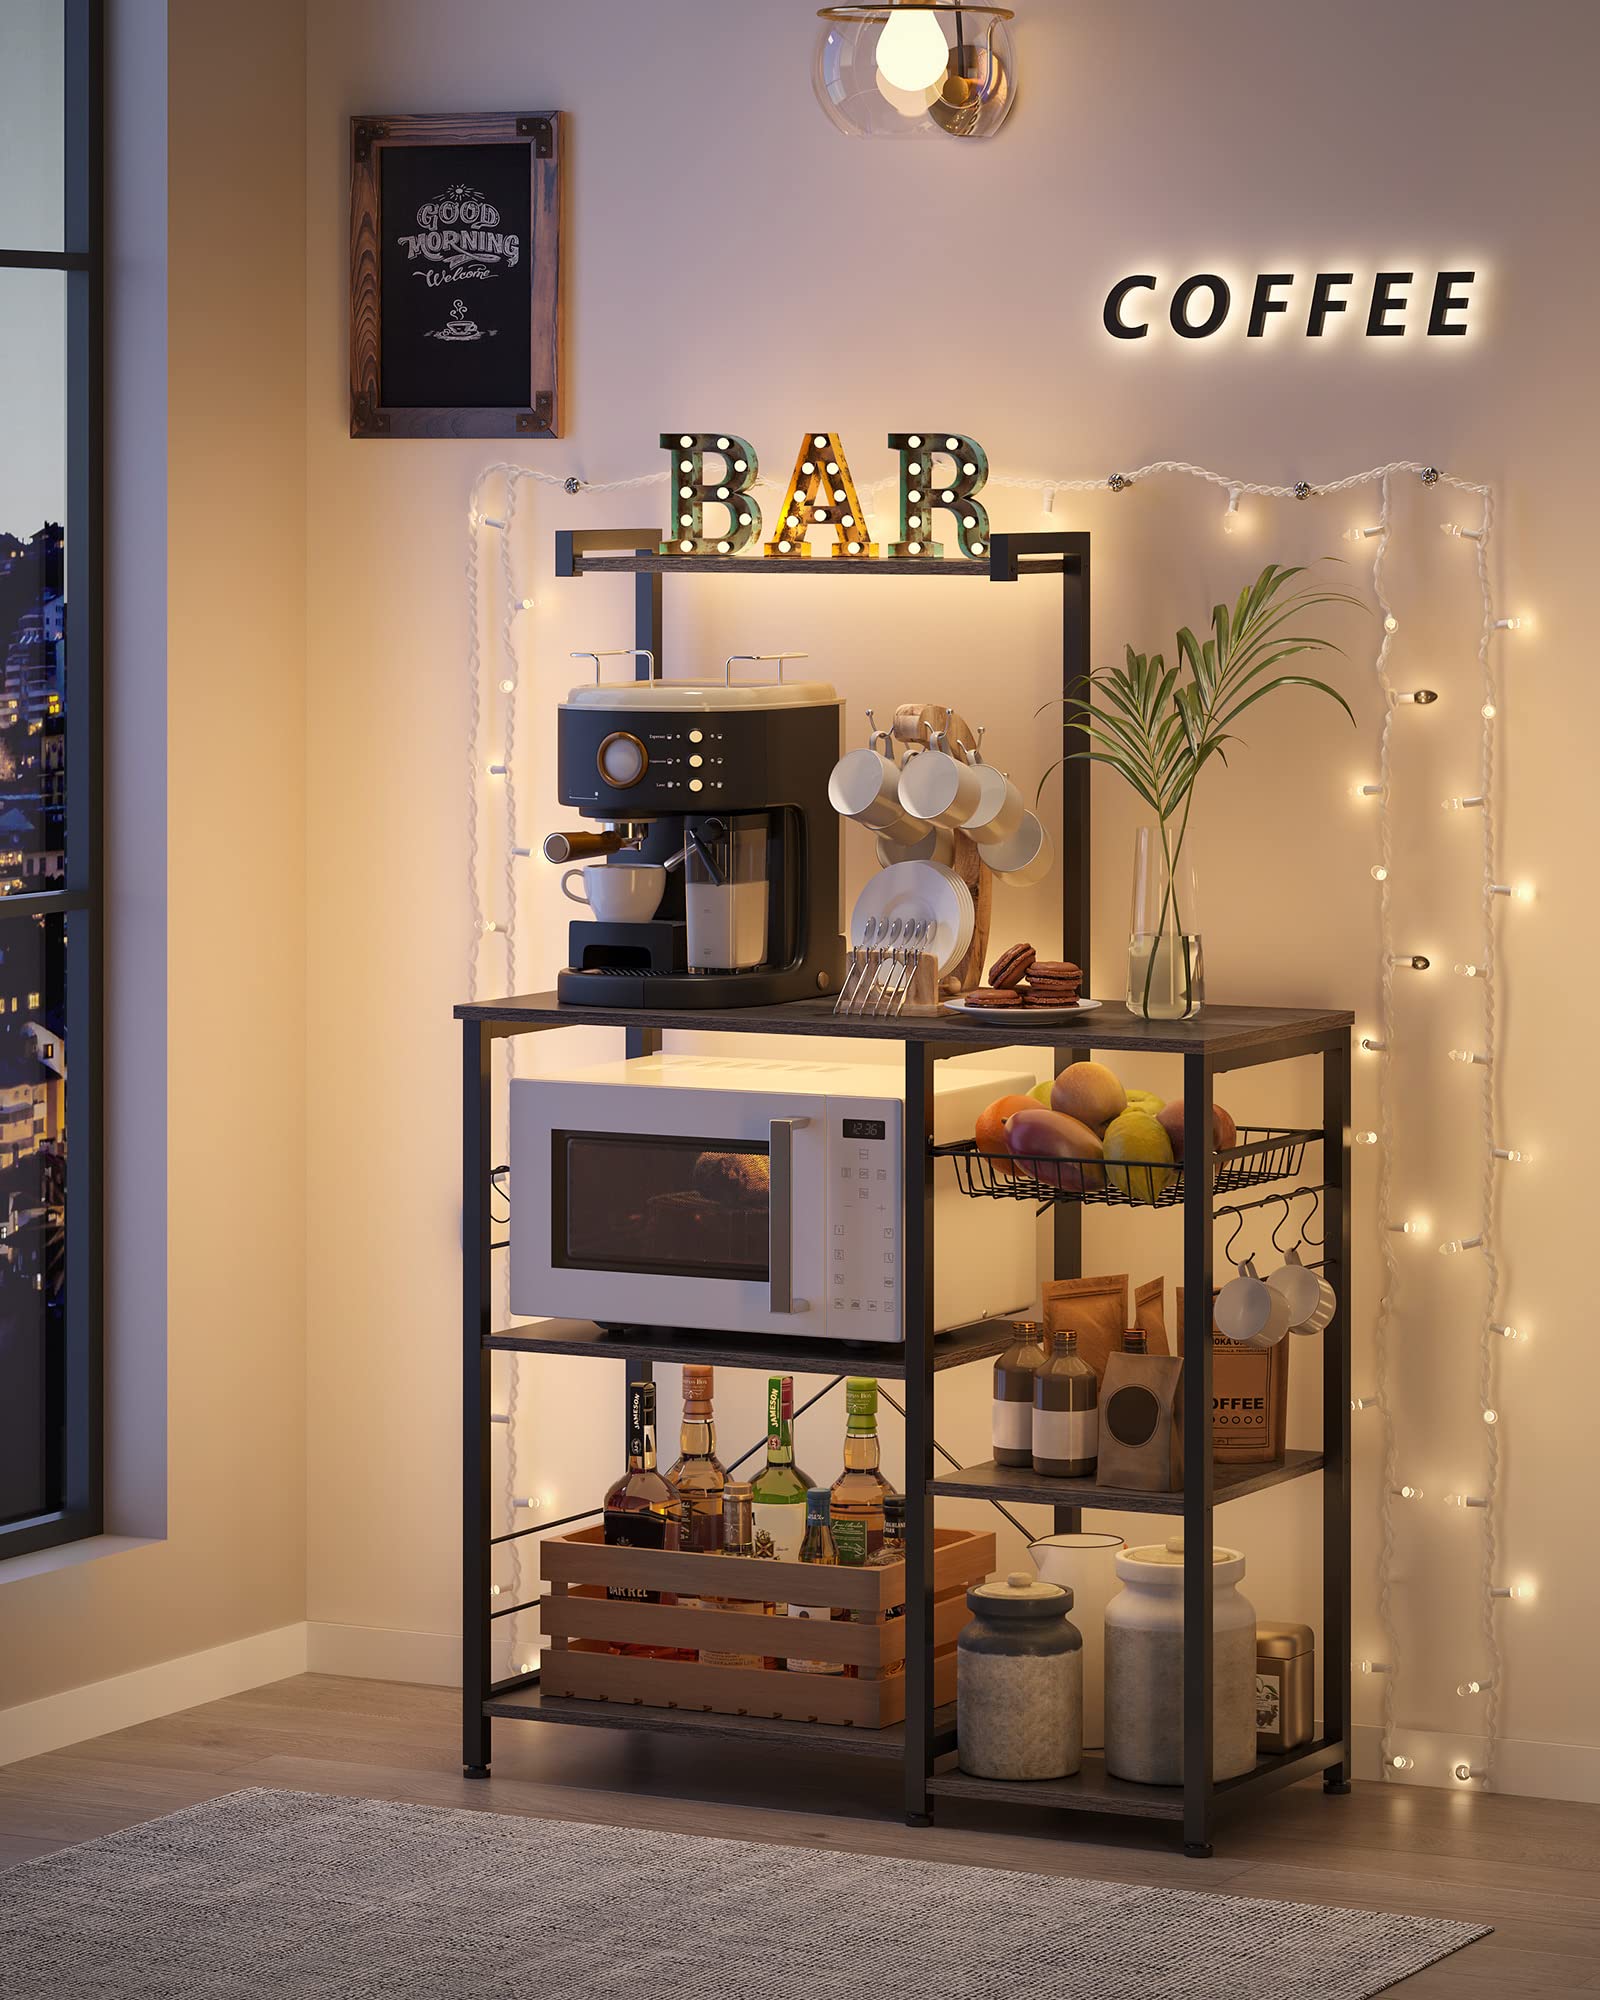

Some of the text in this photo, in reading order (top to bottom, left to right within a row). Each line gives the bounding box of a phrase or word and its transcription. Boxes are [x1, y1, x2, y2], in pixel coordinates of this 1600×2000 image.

[417, 200, 500, 230] GOOD
[398, 229, 520, 268] MORNING
[412, 263, 499, 287] Welcome
[1103, 271, 1475, 339] COFFEE
[659, 432, 991, 560] BAR
[632, 1393, 640, 1430] JAMESON
[769, 1388, 779, 1428] JAMESON
